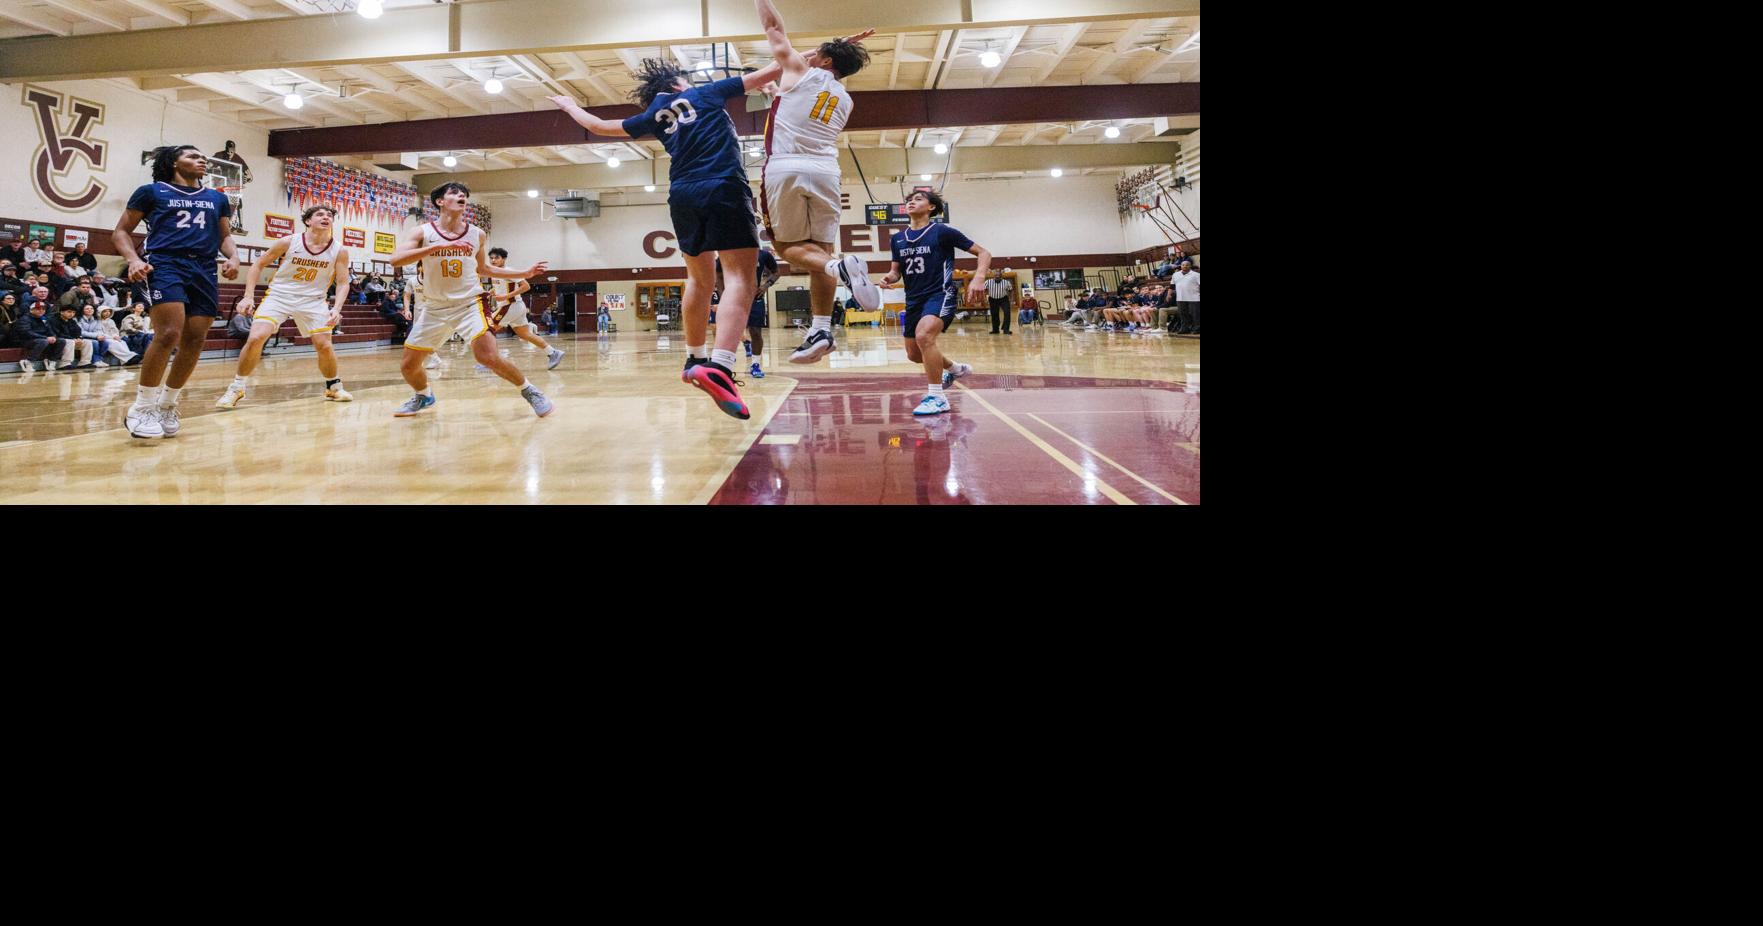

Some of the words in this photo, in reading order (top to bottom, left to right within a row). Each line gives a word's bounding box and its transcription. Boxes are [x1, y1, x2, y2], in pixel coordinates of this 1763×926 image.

[655, 98, 698, 135] 30
[809, 91, 840, 125] 11
[167, 199, 215, 210] JUSTIN-SIENA
[176, 210, 206, 230] 24
[872, 210, 887, 220] 46
[291, 256, 329, 269] CRUSHERS
[440, 259, 463, 278] 13
[905, 256, 925, 275] 23
[292, 267, 318, 282] 20
